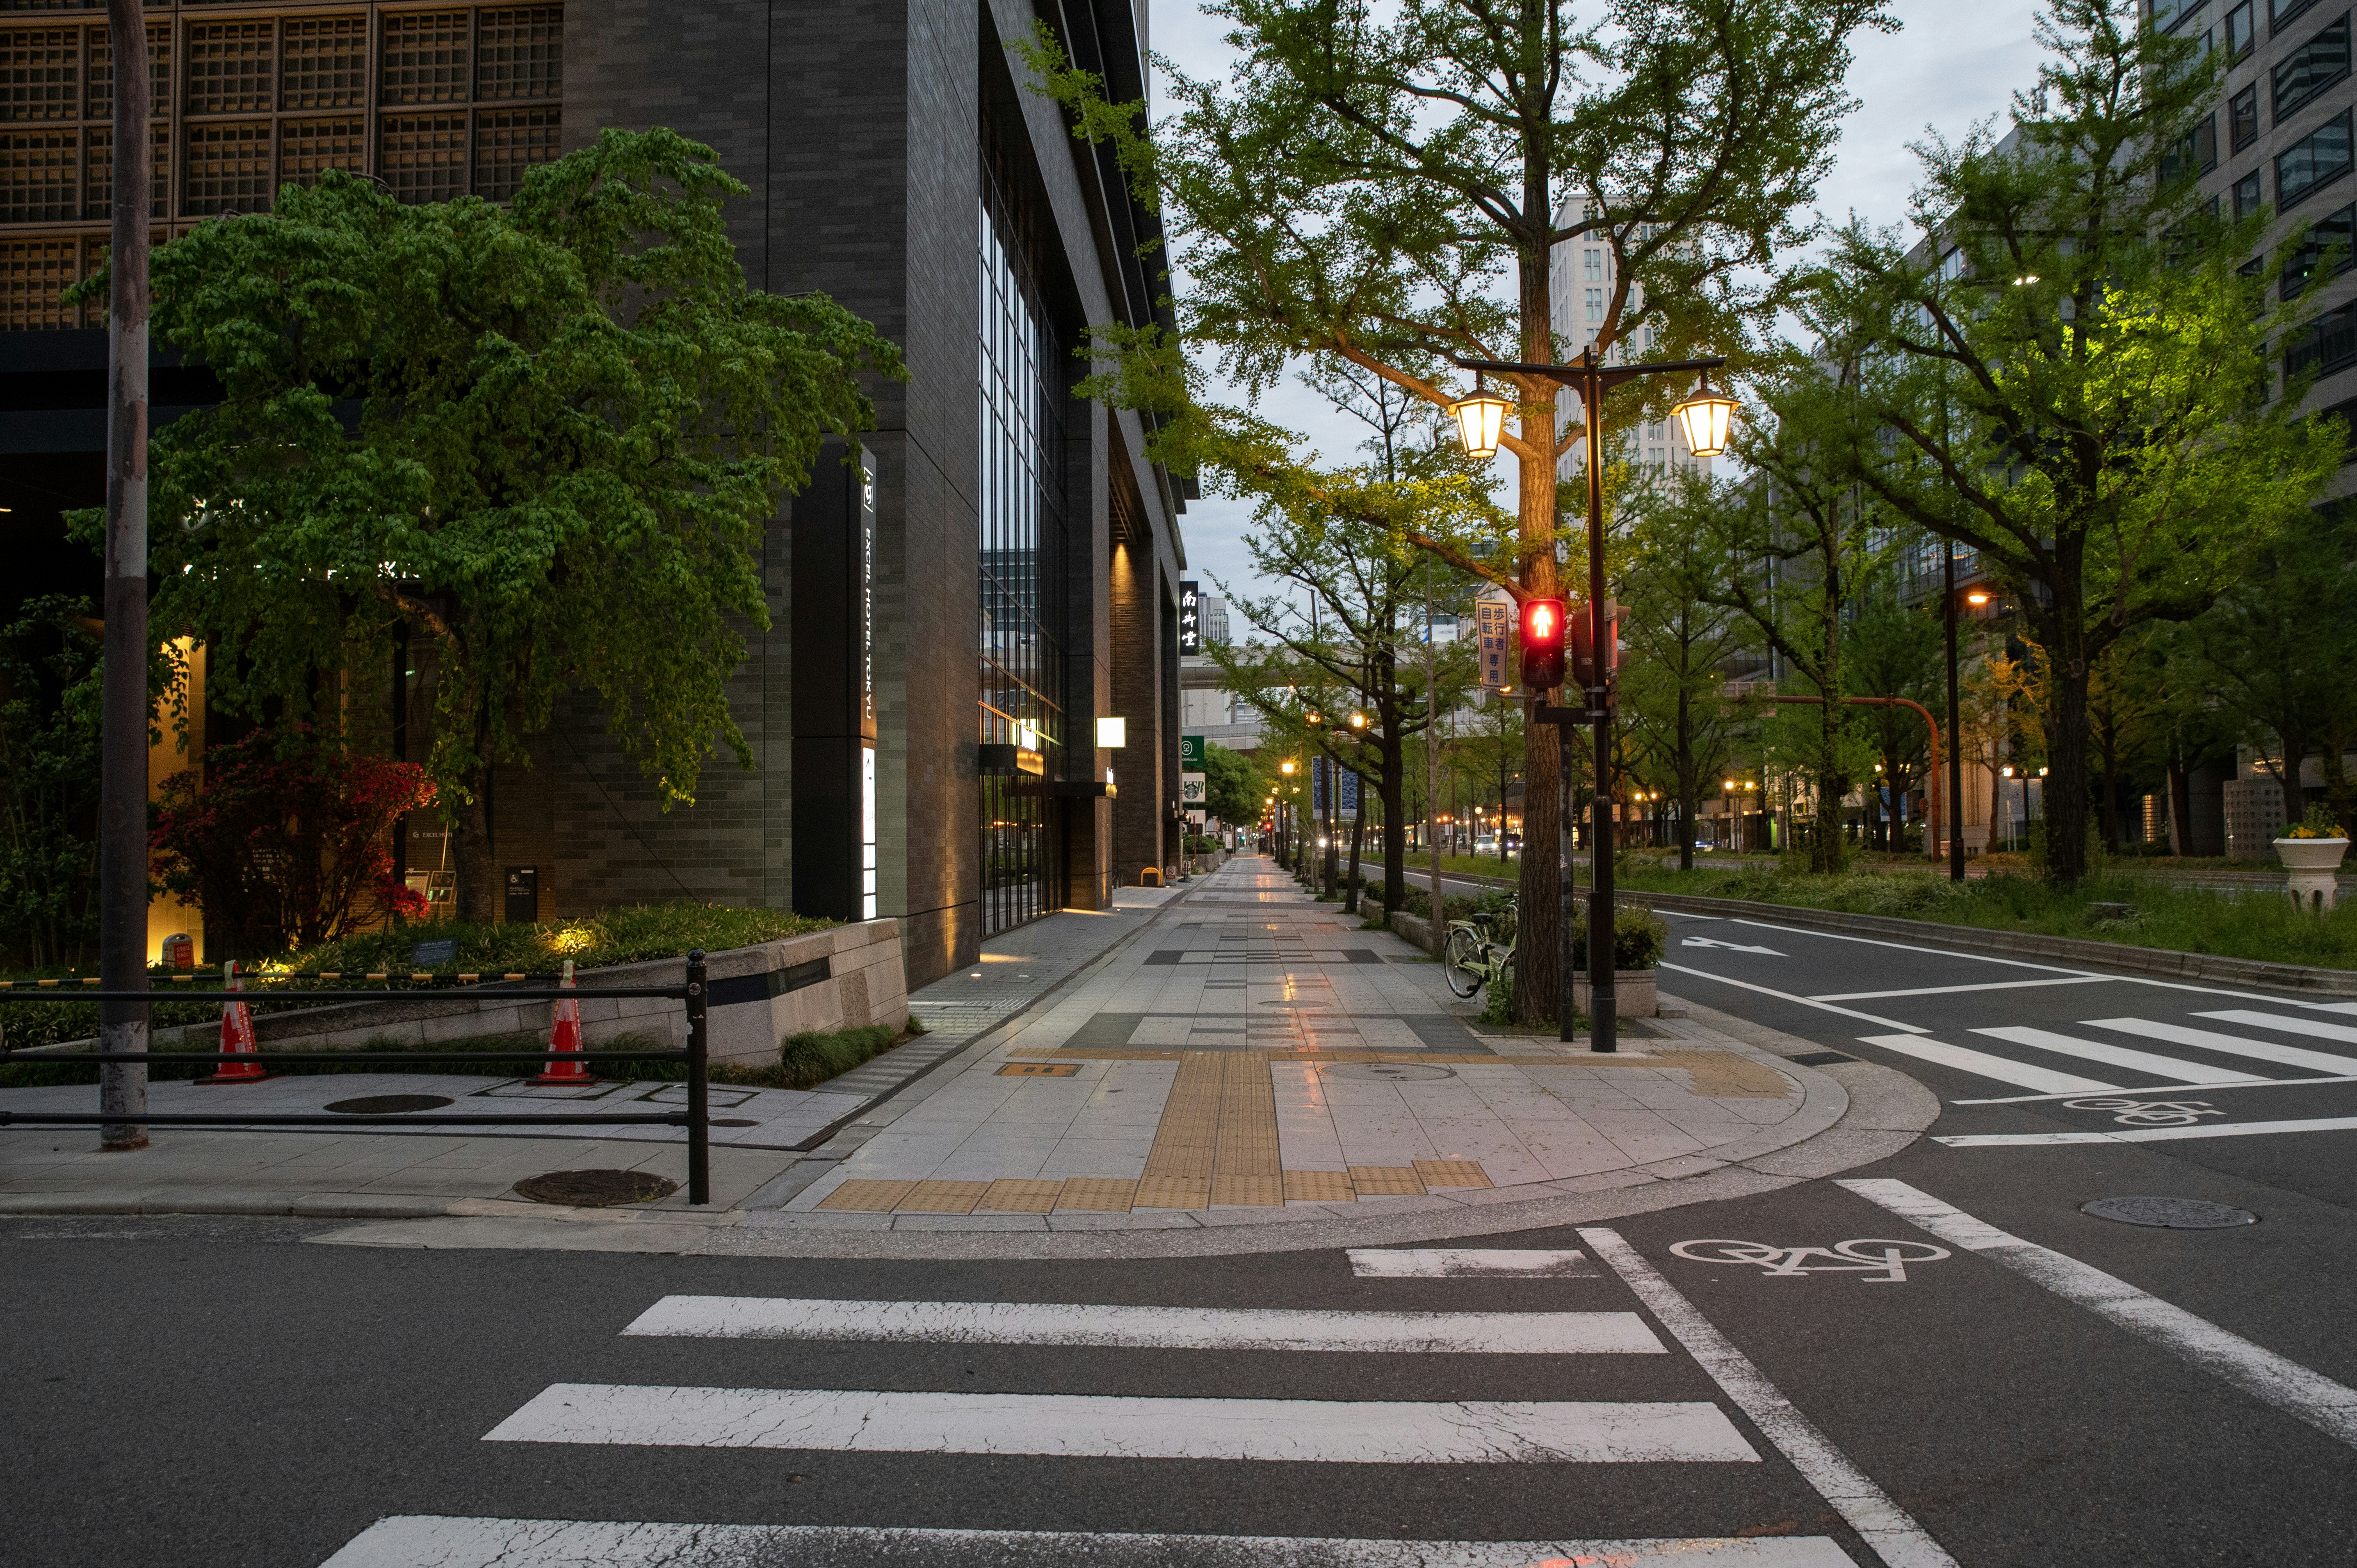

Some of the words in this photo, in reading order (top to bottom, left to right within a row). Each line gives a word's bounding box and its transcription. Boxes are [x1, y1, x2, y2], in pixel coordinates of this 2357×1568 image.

[1182, 590, 1197, 646] 南御堂
[1482, 606, 1494, 650] 自転車
[1494, 607, 1505, 650] 歩行者
[1489, 653, 1499, 683] 専用
